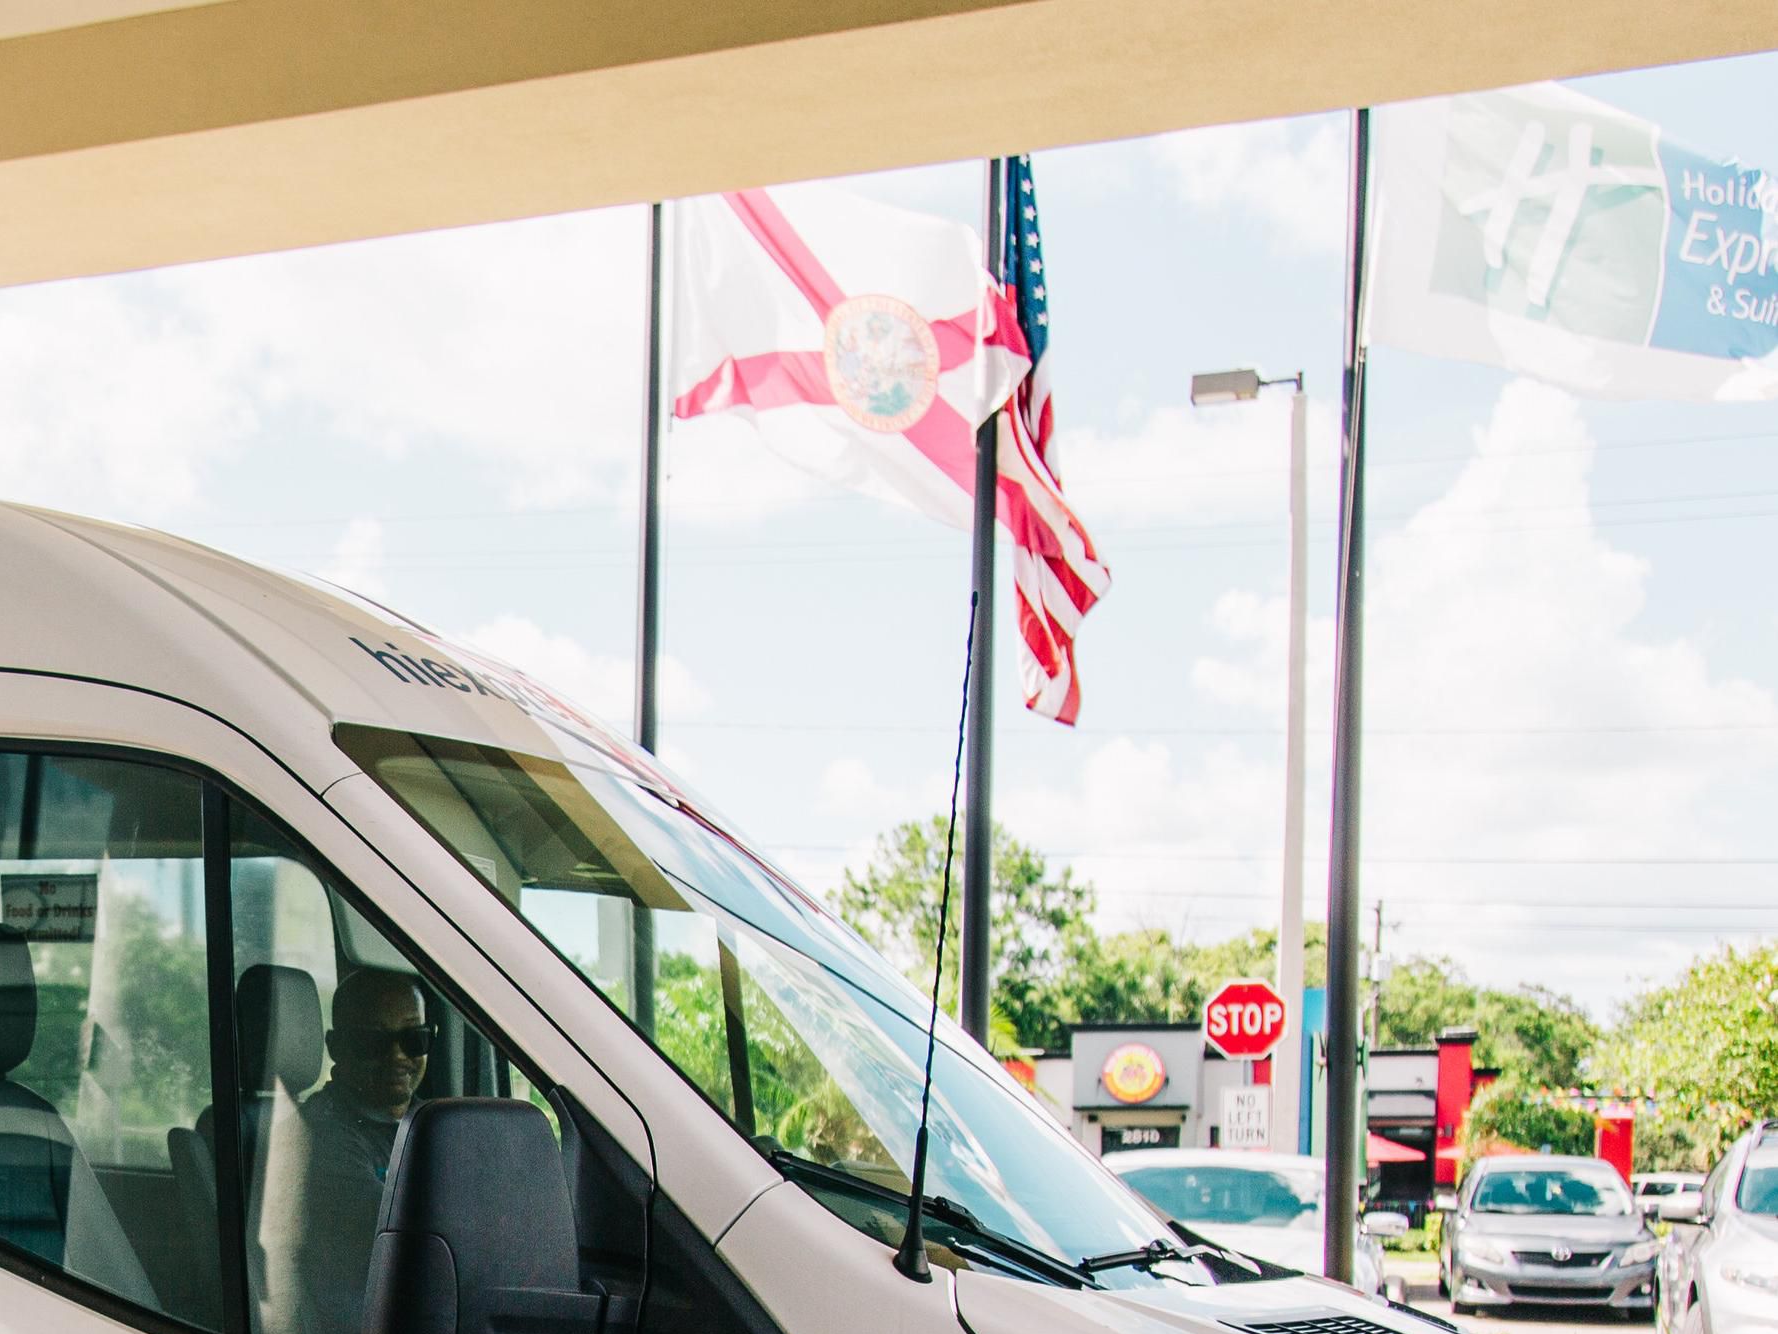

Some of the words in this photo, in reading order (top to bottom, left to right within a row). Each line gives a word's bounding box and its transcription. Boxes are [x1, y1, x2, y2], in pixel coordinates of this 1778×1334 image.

[1706, 284, 1726, 316] &
[1208, 1002, 1283, 1037] STOP
[1236, 1095, 1256, 1107] NO
[1228, 1111, 1263, 1124] LEFT
[1228, 1127, 1266, 1141] TURN
